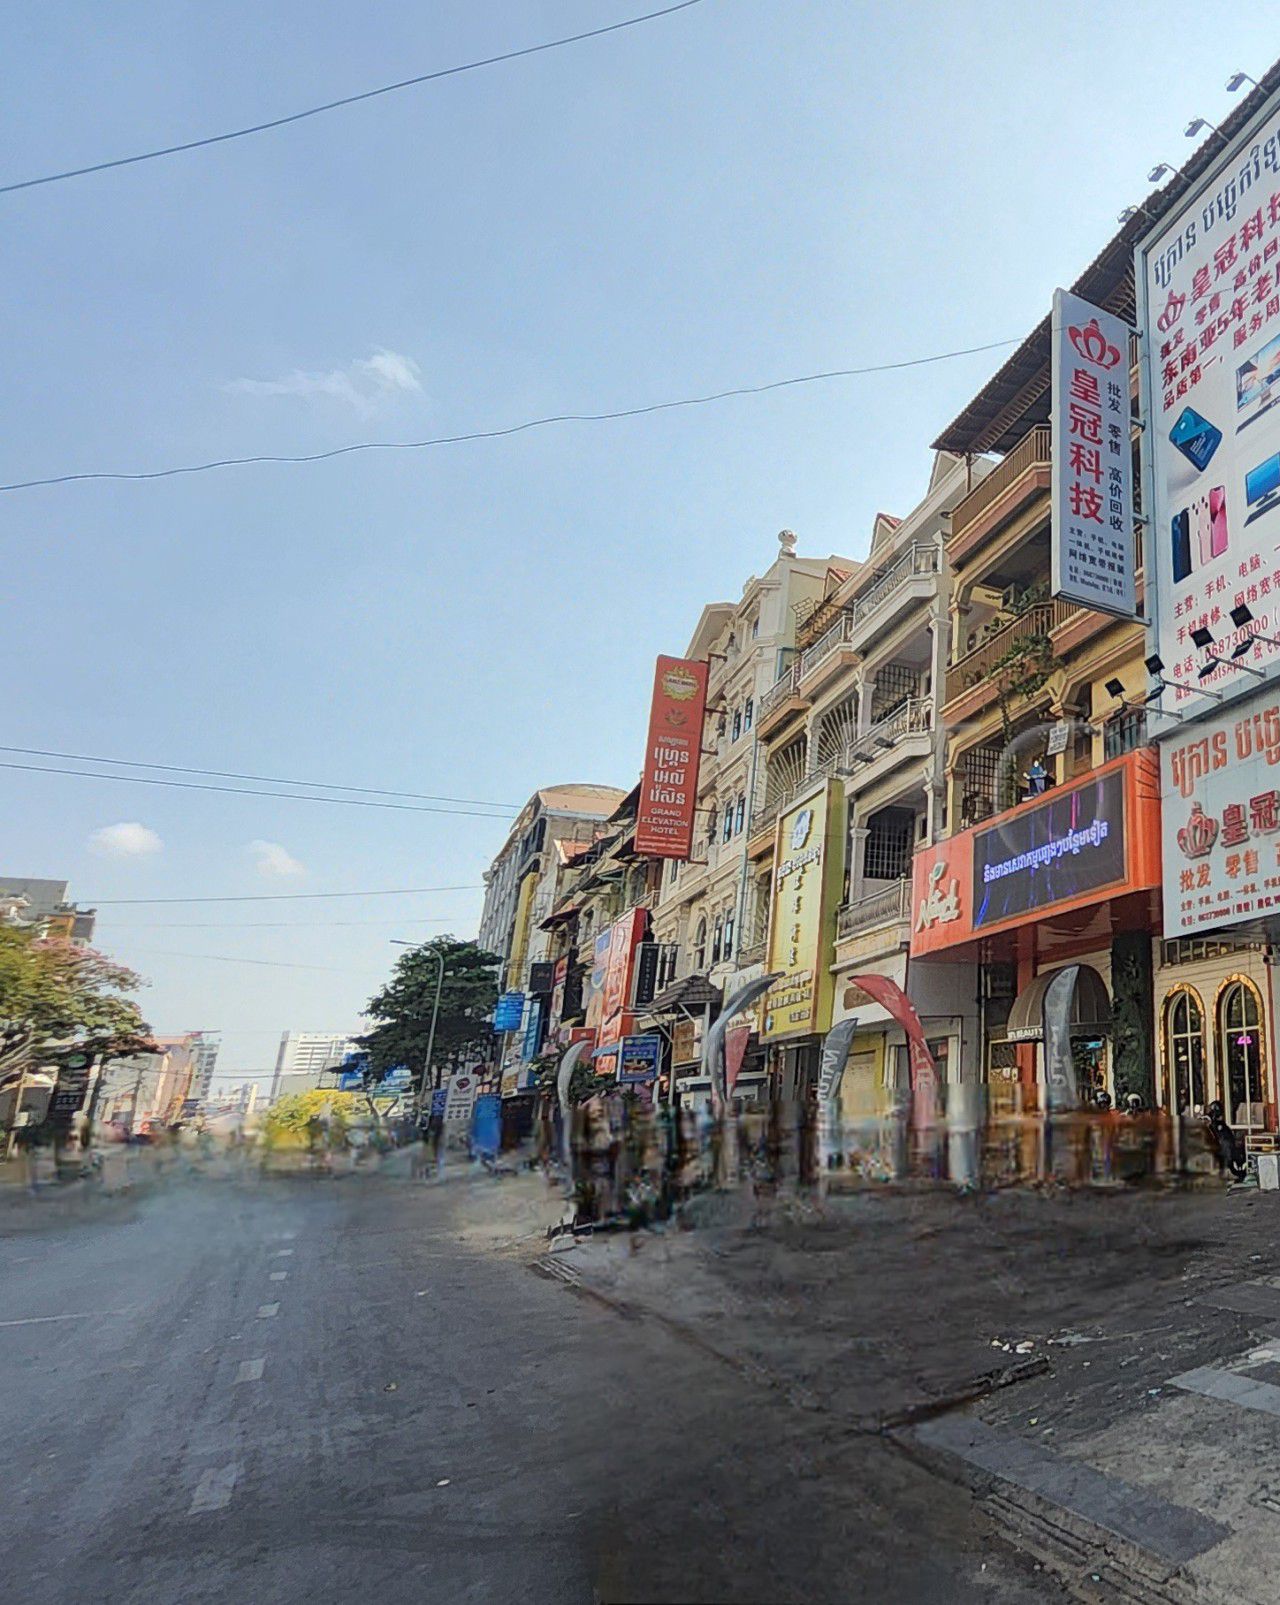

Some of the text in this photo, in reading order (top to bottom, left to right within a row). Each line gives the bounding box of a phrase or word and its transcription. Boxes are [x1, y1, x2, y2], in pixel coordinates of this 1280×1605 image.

[1069, 368, 1104, 525] 皇冠科技
[1107, 381, 1124, 533] 批发 零售 高价回收
[641, 816, 689, 827] ELEVATION
[650, 807, 682, 817] GRAND
[650, 825, 680, 835] HOTEL
[1180, 863, 1212, 893] 批发
[1225, 849, 1260, 879] 零售
